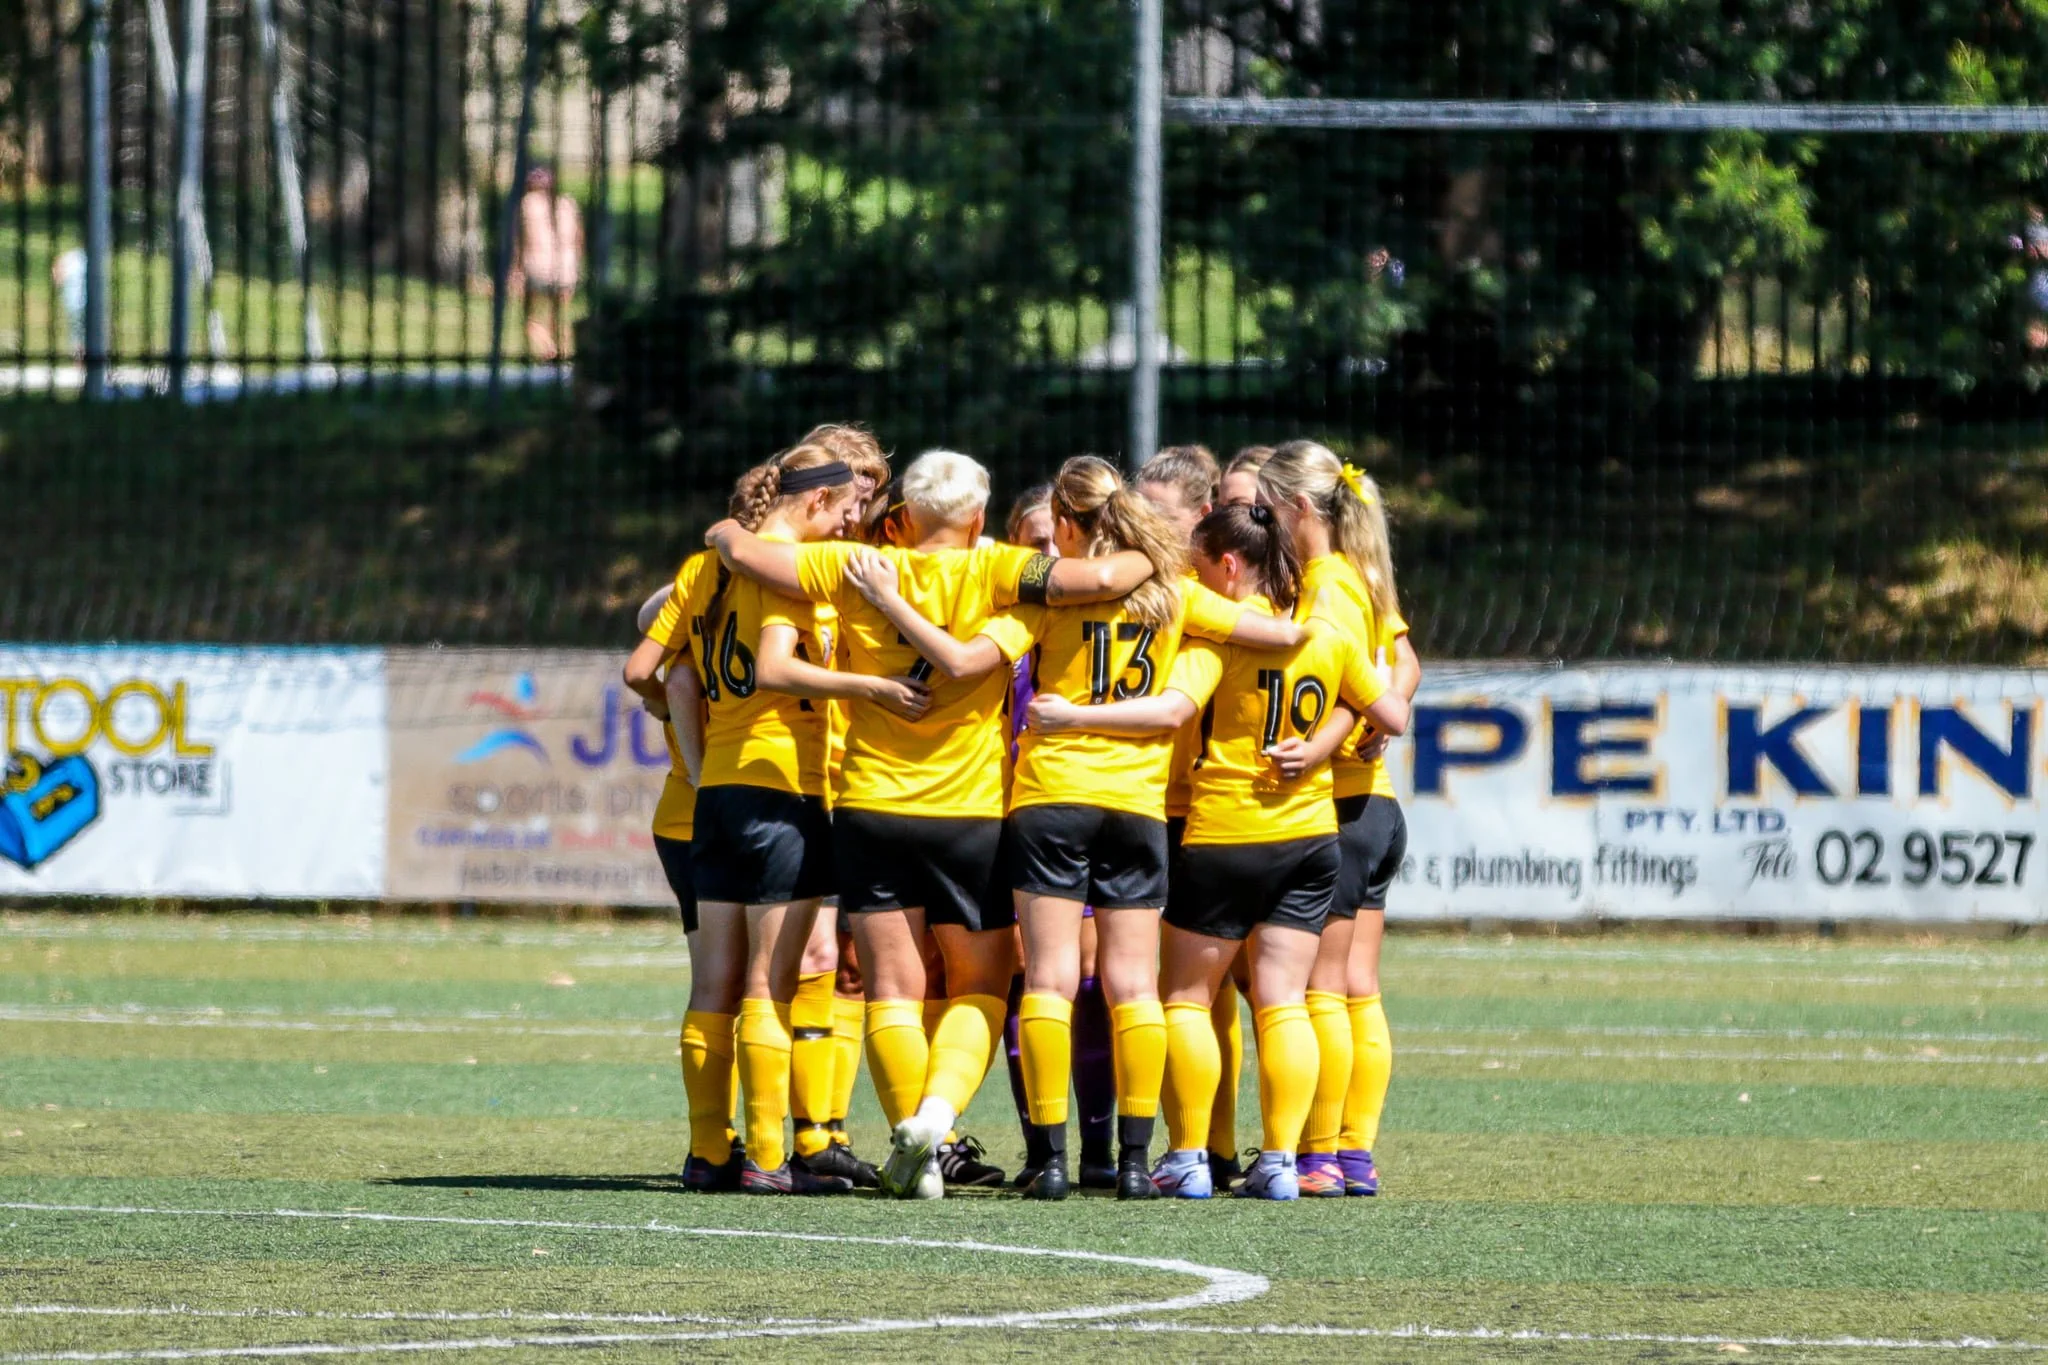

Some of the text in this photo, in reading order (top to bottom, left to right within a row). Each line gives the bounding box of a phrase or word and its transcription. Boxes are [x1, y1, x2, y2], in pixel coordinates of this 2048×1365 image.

[692, 611, 756, 701] 16
[1082, 620, 1157, 702] 13
[0, 677, 216, 757] TOOL
[108, 760, 211, 797] STORE
[1453, 844, 1582, 898] plumbing
[1593, 843, 1698, 897] fittings
[1814, 829, 1891, 887] 02
[1901, 829, 2036, 887] 9527
